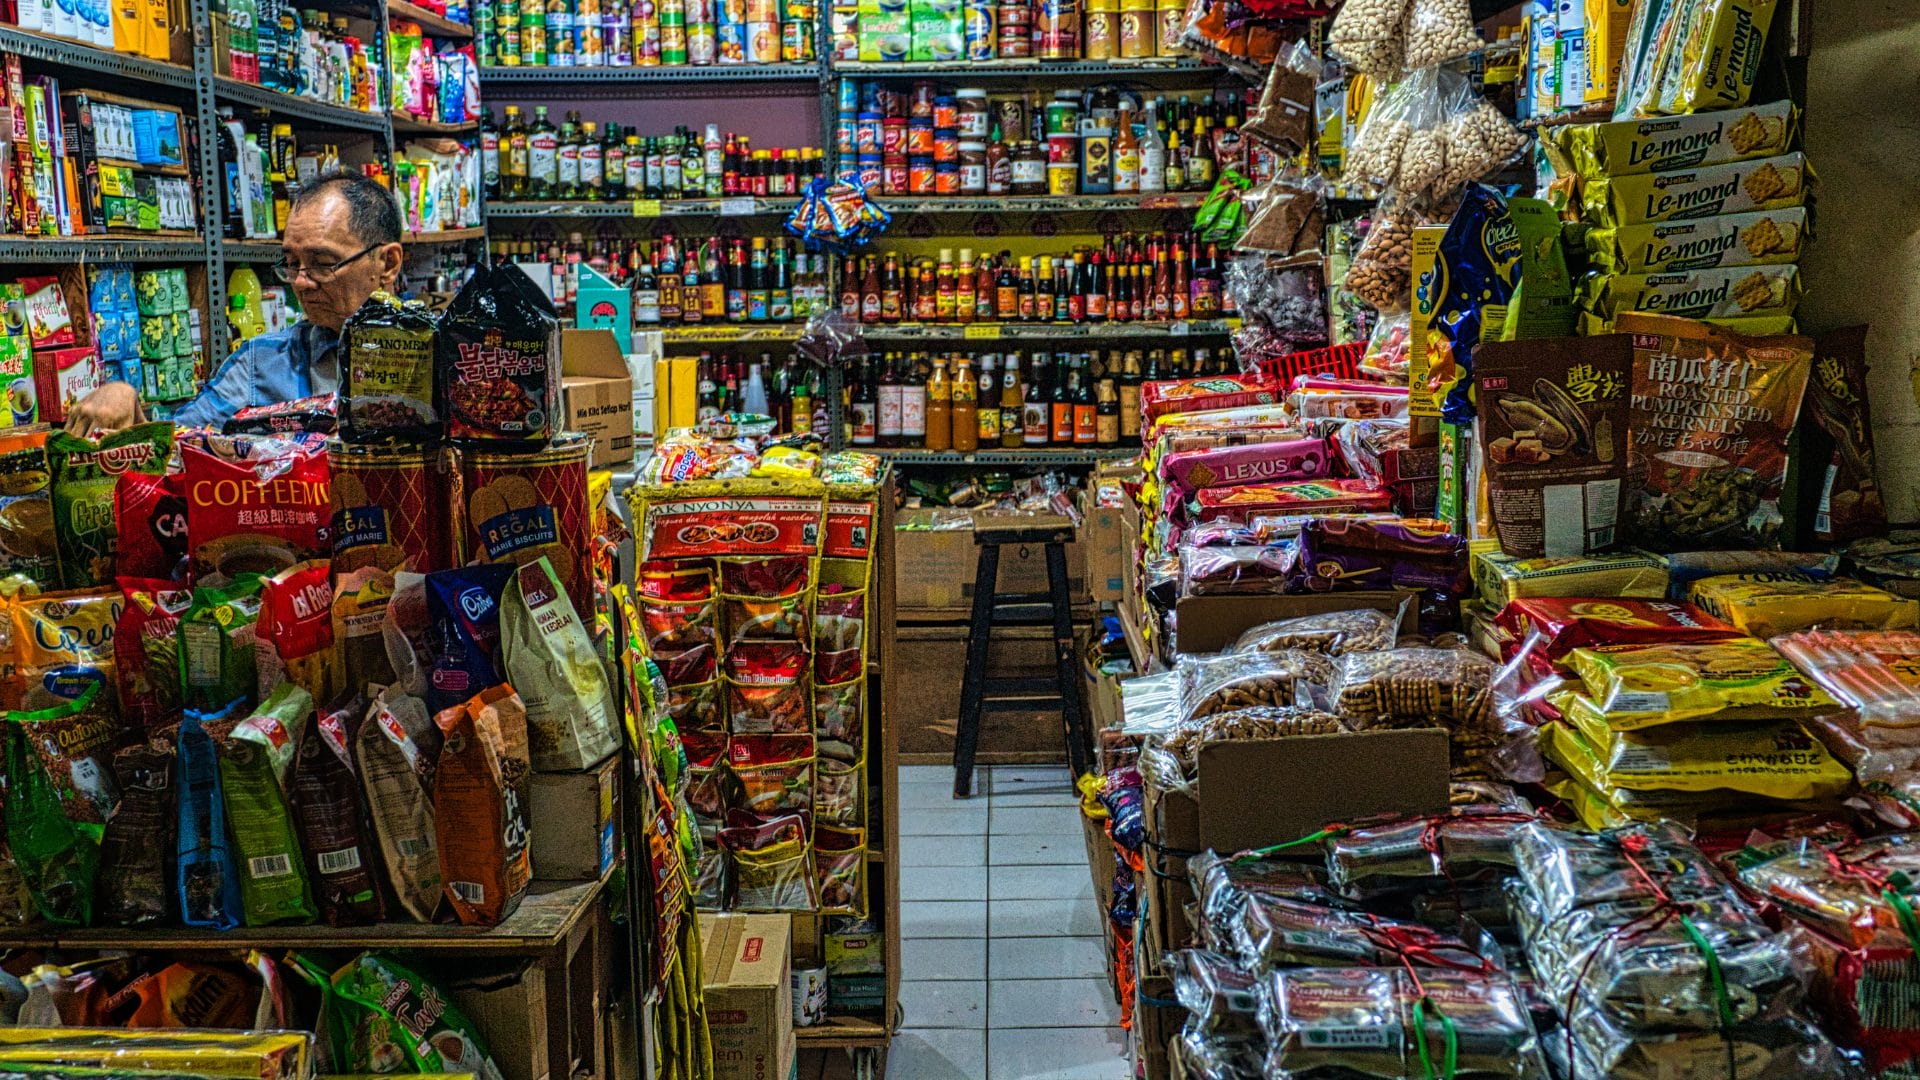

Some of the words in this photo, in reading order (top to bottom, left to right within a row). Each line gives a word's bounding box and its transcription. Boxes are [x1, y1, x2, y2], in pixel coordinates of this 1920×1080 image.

[1717, 4, 1753, 101] Le-mond
[1628, 121, 1724, 166] Le-mond
[1646, 173, 1740, 219] Le-mond
[1643, 225, 1739, 267] Le-mond
[1633, 279, 1730, 312] Le-mond
[454, 342, 545, 382] 불닭볶음면
[1659, 382, 1750, 405] ROASTED
[1630, 394, 1721, 418] PUMPKIN
[1722, 403, 1773, 423] SEED
[1651, 412, 1746, 436] KERNELS
[1635, 427, 1750, 456] かぼちゃの種
[1224, 459, 1289, 481] LEXUS
[237, 508, 319, 526] 超級即溶咖啡
[683, 501, 755, 513] NYONYA
[355, 531, 384, 543] MARIE
[488, 515, 548, 544] REGAL
[490, 538, 514, 557] MARIE
[513, 530, 554, 546] BISCUITS
